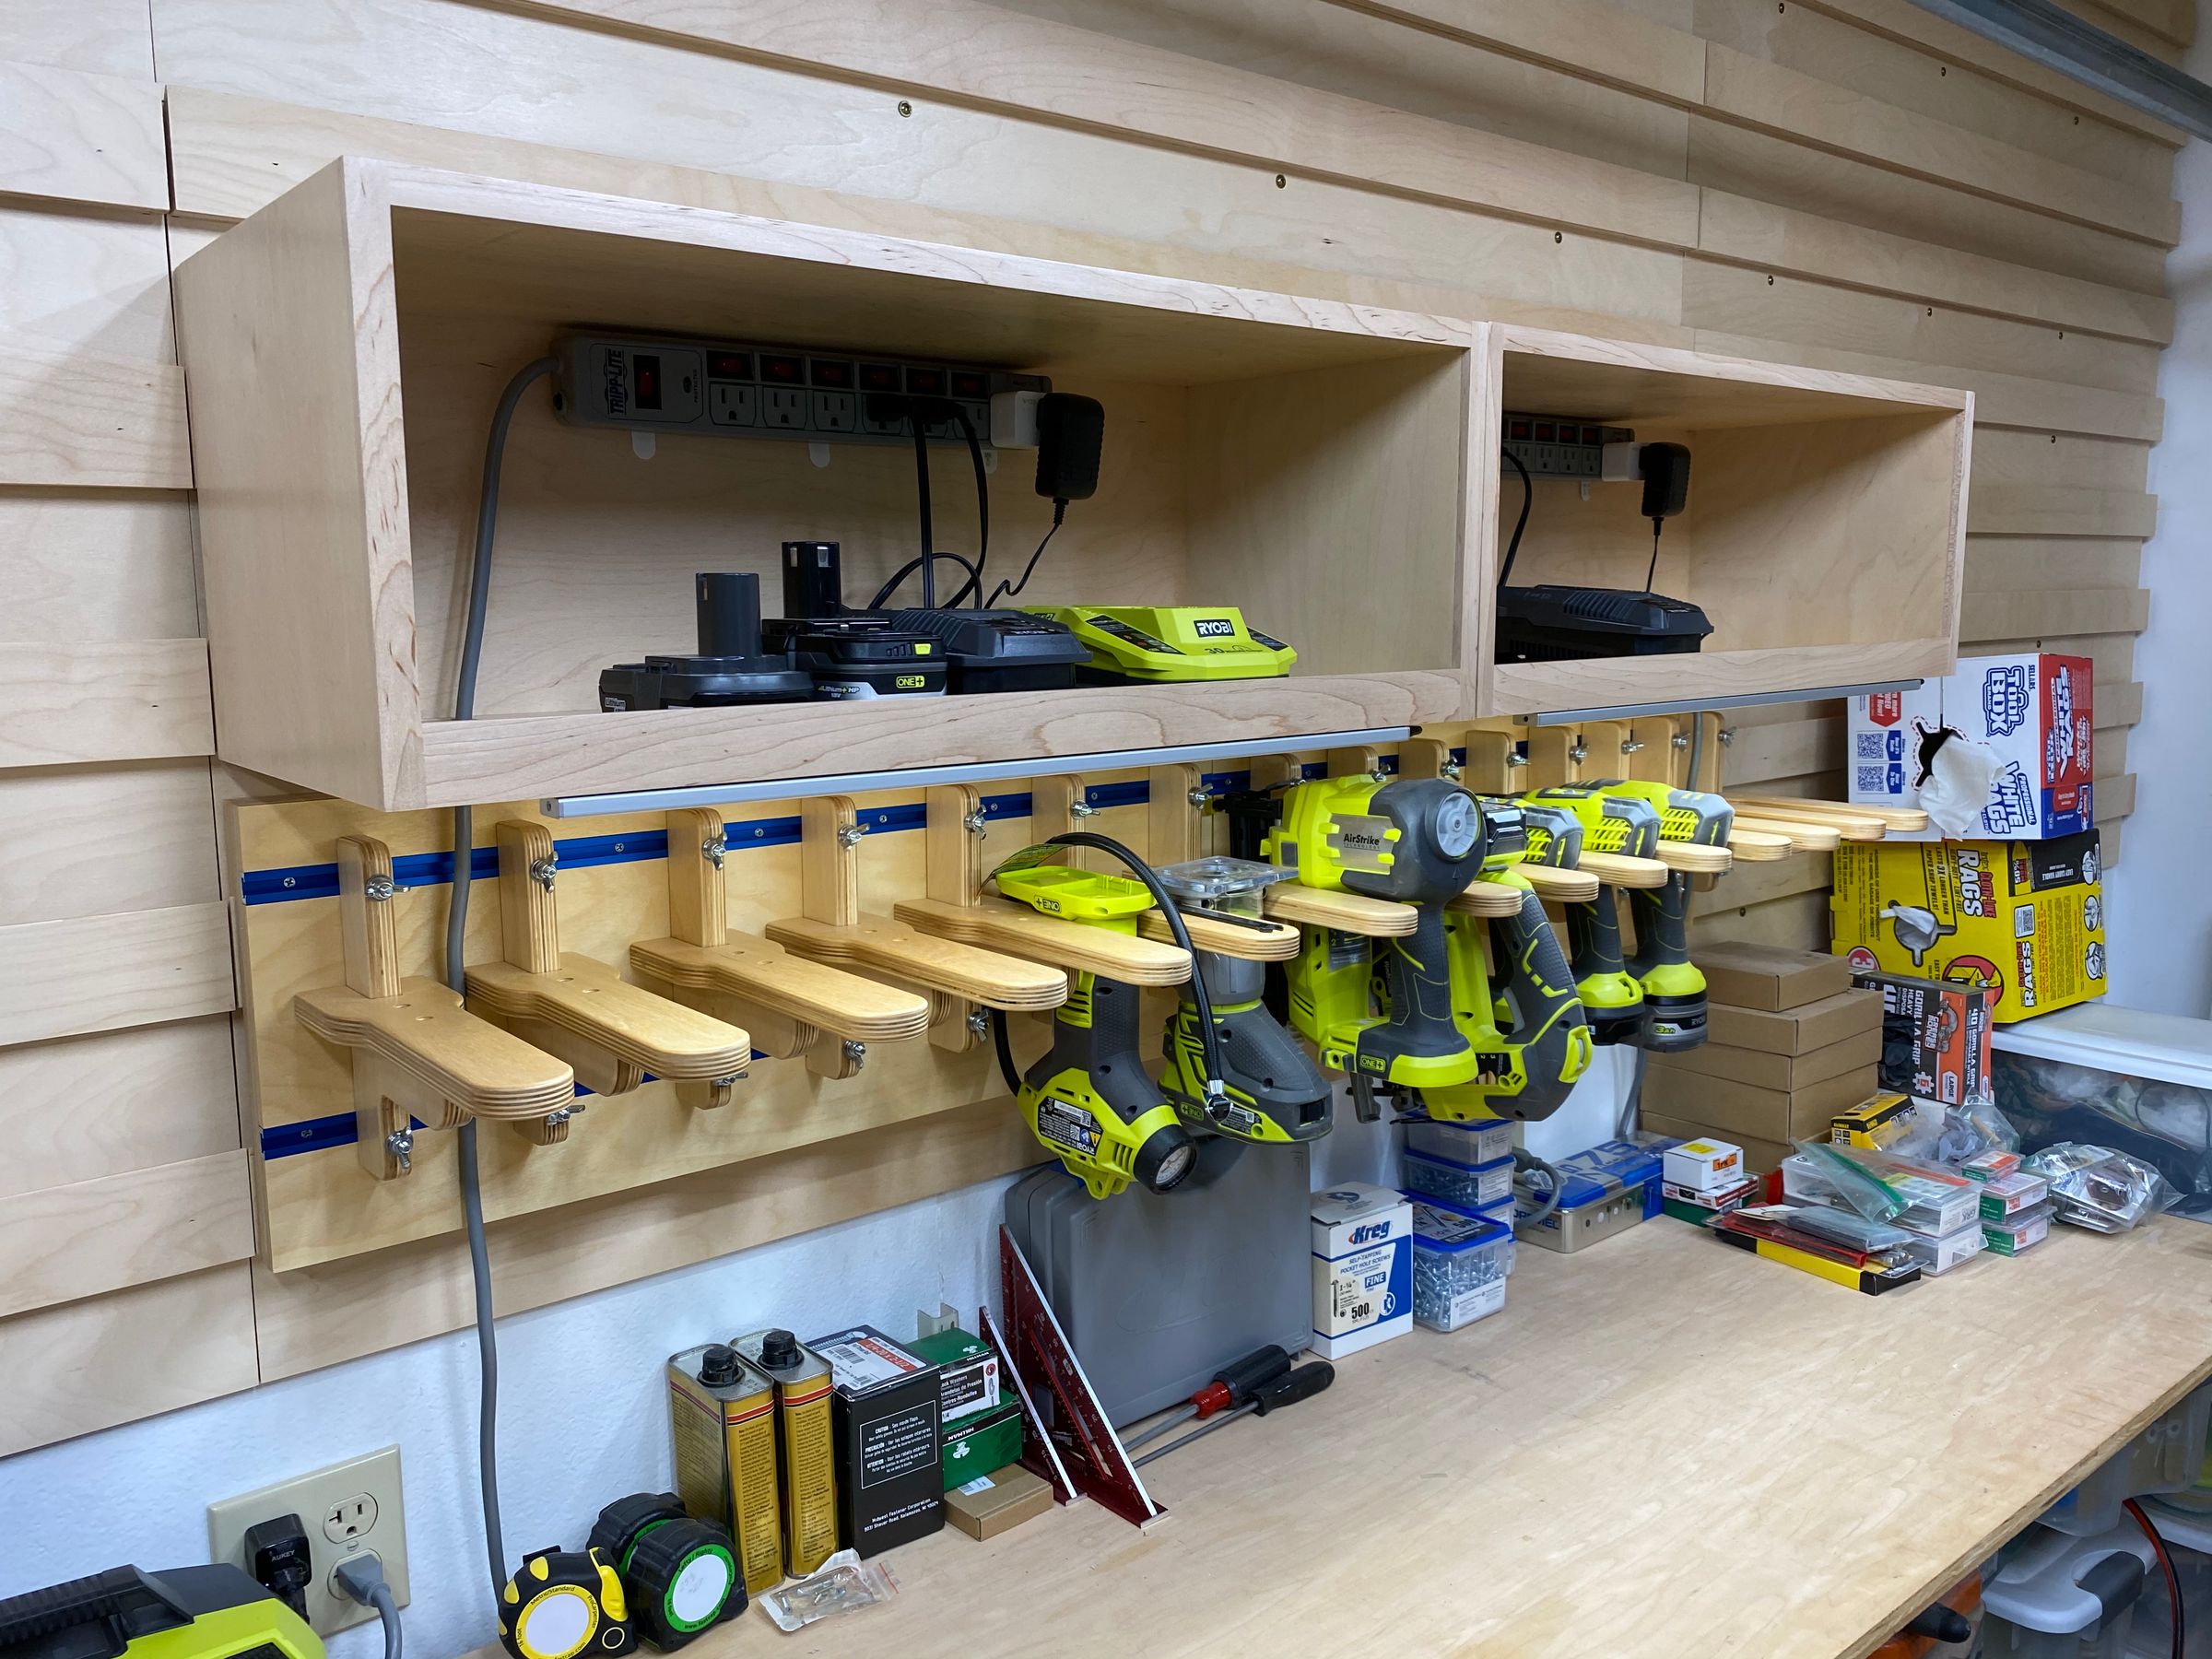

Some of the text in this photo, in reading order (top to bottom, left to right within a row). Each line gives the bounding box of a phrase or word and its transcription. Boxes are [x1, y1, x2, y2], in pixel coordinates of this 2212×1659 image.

[1196, 622, 1232, 635] RYOBI
[898, 677, 924, 687] ONE+
[2028, 665, 2036, 690] SELLARS
[1990, 672, 2008, 733] BOX
[2007, 670, 2021, 727] TOOL
[2060, 666, 2074, 757] RAGS
[2056, 677, 2067, 779] WHITE
[1998, 761, 2024, 828] WHITE
[2018, 775, 2036, 824] PROFESSIONAL
[1344, 833, 1380, 846] AirStrike
[1925, 849, 1934, 867] PAPER
[1936, 847, 1944, 865] LASTS
[1936, 865, 1946, 876] 3X
[2013, 860, 2021, 884] 50%
[1939, 876, 1947, 899] LONGER
[1957, 849, 1983, 917] RAGS
[1036, 898, 1060, 912] ONE+
[1929, 885, 1939, 911] TOWELS!
[1954, 886, 1962, 913] LINT-FREE
[1979, 872, 1997, 918] CLOTH-LIKE
[2022, 941, 2035, 1007] RAGS
[1906, 988, 1914, 1016] HEAVY
[1971, 1008, 1978, 1026] 40
[1361, 1056, 1382, 1071] ONE+
[1912, 1040, 1921, 1065] GRIP
[1077, 1142, 1095, 1155] RYOBI
[1353, 1220, 1391, 1245] Kreg
[1340, 1264, 1359, 1275] POCKET
[1359, 1260, 1371, 1268] HOLE
[1371, 1253, 1391, 1265] SCREWS
[1348, 1250, 1382, 1265] SELF-TAPPING
[1366, 1274, 1385, 1287] FINE
[1351, 1301, 1370, 1320] 500
[966, 1351, 990, 1362] HILLMAN
[949, 1375, 968, 1384] Washers
[967, 1379, 982, 1388] Presión
[947, 1427, 975, 1441] HILLMAN
[871, 1498, 932, 1524] Midwest Fastener Corporation
[271, 1549, 295, 1562] AUKEY
[678, 1558, 692, 1572] Lefty
[695, 1548, 713, 1559] Righty
[530, 1586, 576, 1606] Metric/Standard
